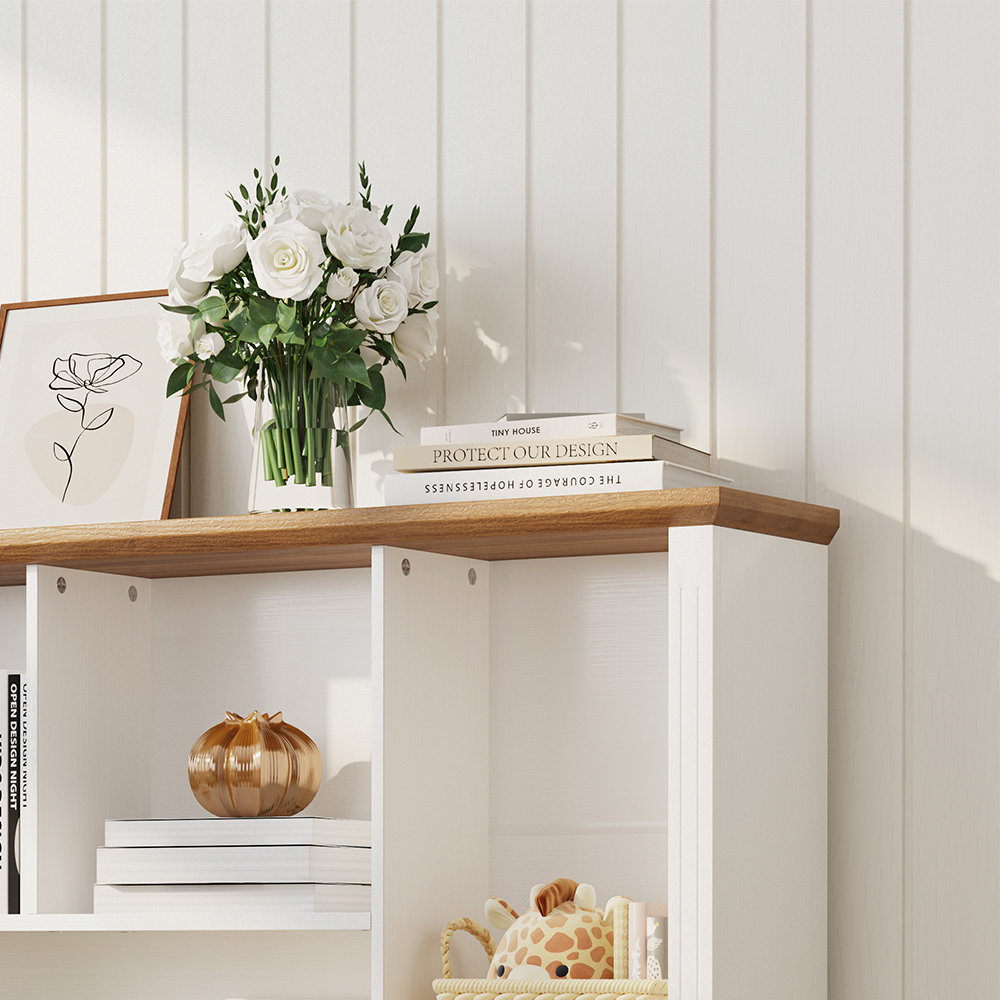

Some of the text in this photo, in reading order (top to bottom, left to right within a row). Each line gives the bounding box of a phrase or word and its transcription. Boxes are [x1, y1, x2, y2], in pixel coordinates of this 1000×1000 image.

[491, 426, 541, 438] TINY HOUSE
[433, 441, 619, 464] PROTECT OUR DESIGN
[424, 475, 622, 494] THE COURAGE OF HOPELESSNESS
[10, 683, 18, 811] OPEN DESIGN NIGHT
